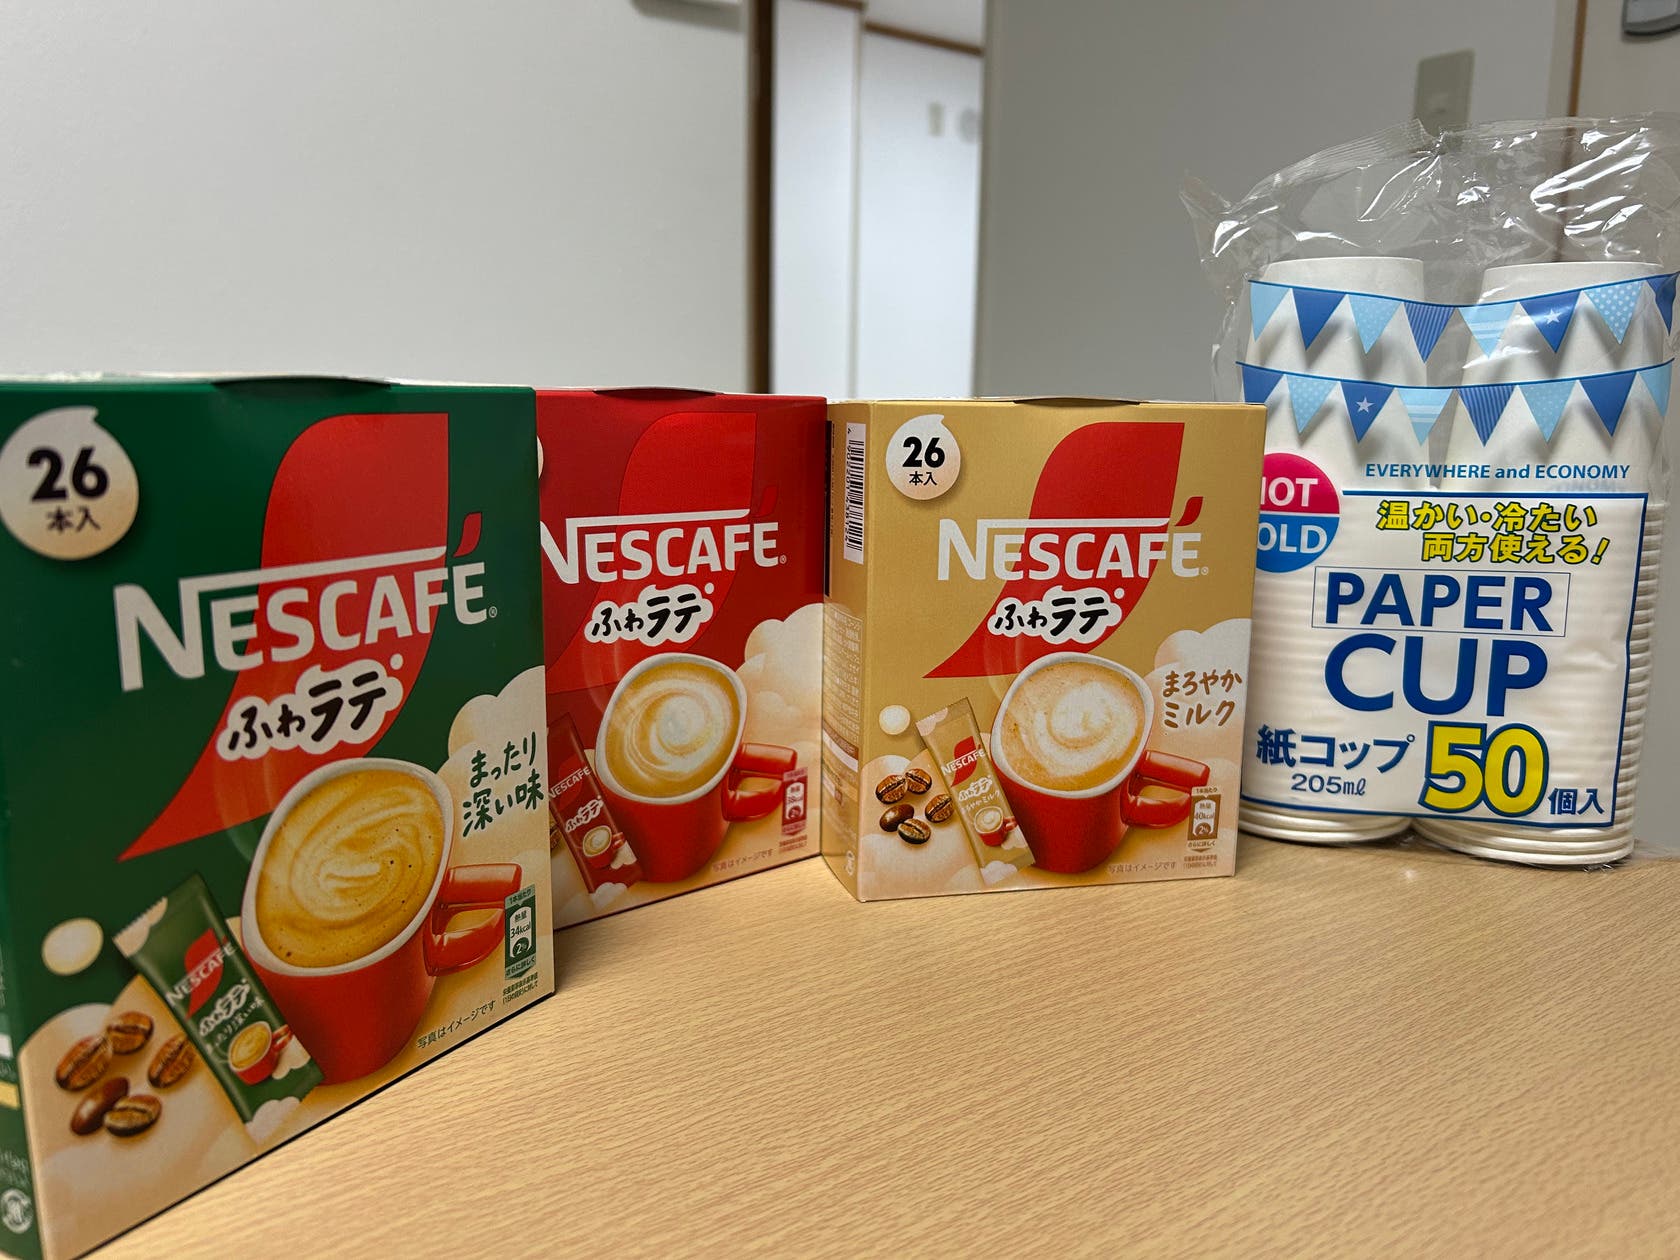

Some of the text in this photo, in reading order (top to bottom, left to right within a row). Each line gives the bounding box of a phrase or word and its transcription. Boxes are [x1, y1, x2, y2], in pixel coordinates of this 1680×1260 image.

[902, 436, 945, 469] 26
[1365, 463, 1630, 480] EVERYWHERE and ECONOMY
[27, 446, 109, 502] 26
[909, 471, 938, 486] 本入
[47, 507, 101, 533] 本入
[1376, 500, 1598, 533] 温かい・冷たい
[1421, 533, 1611, 566] 両方使える！
[591, 592, 702, 638] ふわラテ
[995, 597, 1110, 636] ふわラテ
[1325, 571, 1554, 632] PAPER
[1162, 669, 1243, 698] まろやか
[1324, 632, 1549, 717] CUP
[228, 671, 387, 752] ふわラテ
[1163, 700, 1236, 729] ミルク
[470, 731, 537, 788] まったり
[1256, 724, 1416, 774] 紙コップ
[1418, 720, 1605, 818] 50 個入
[462, 768, 545, 838] 深い味
[510, 922, 532, 939] 34kcal
[417, 999, 497, 1049] 写真はイメージです
